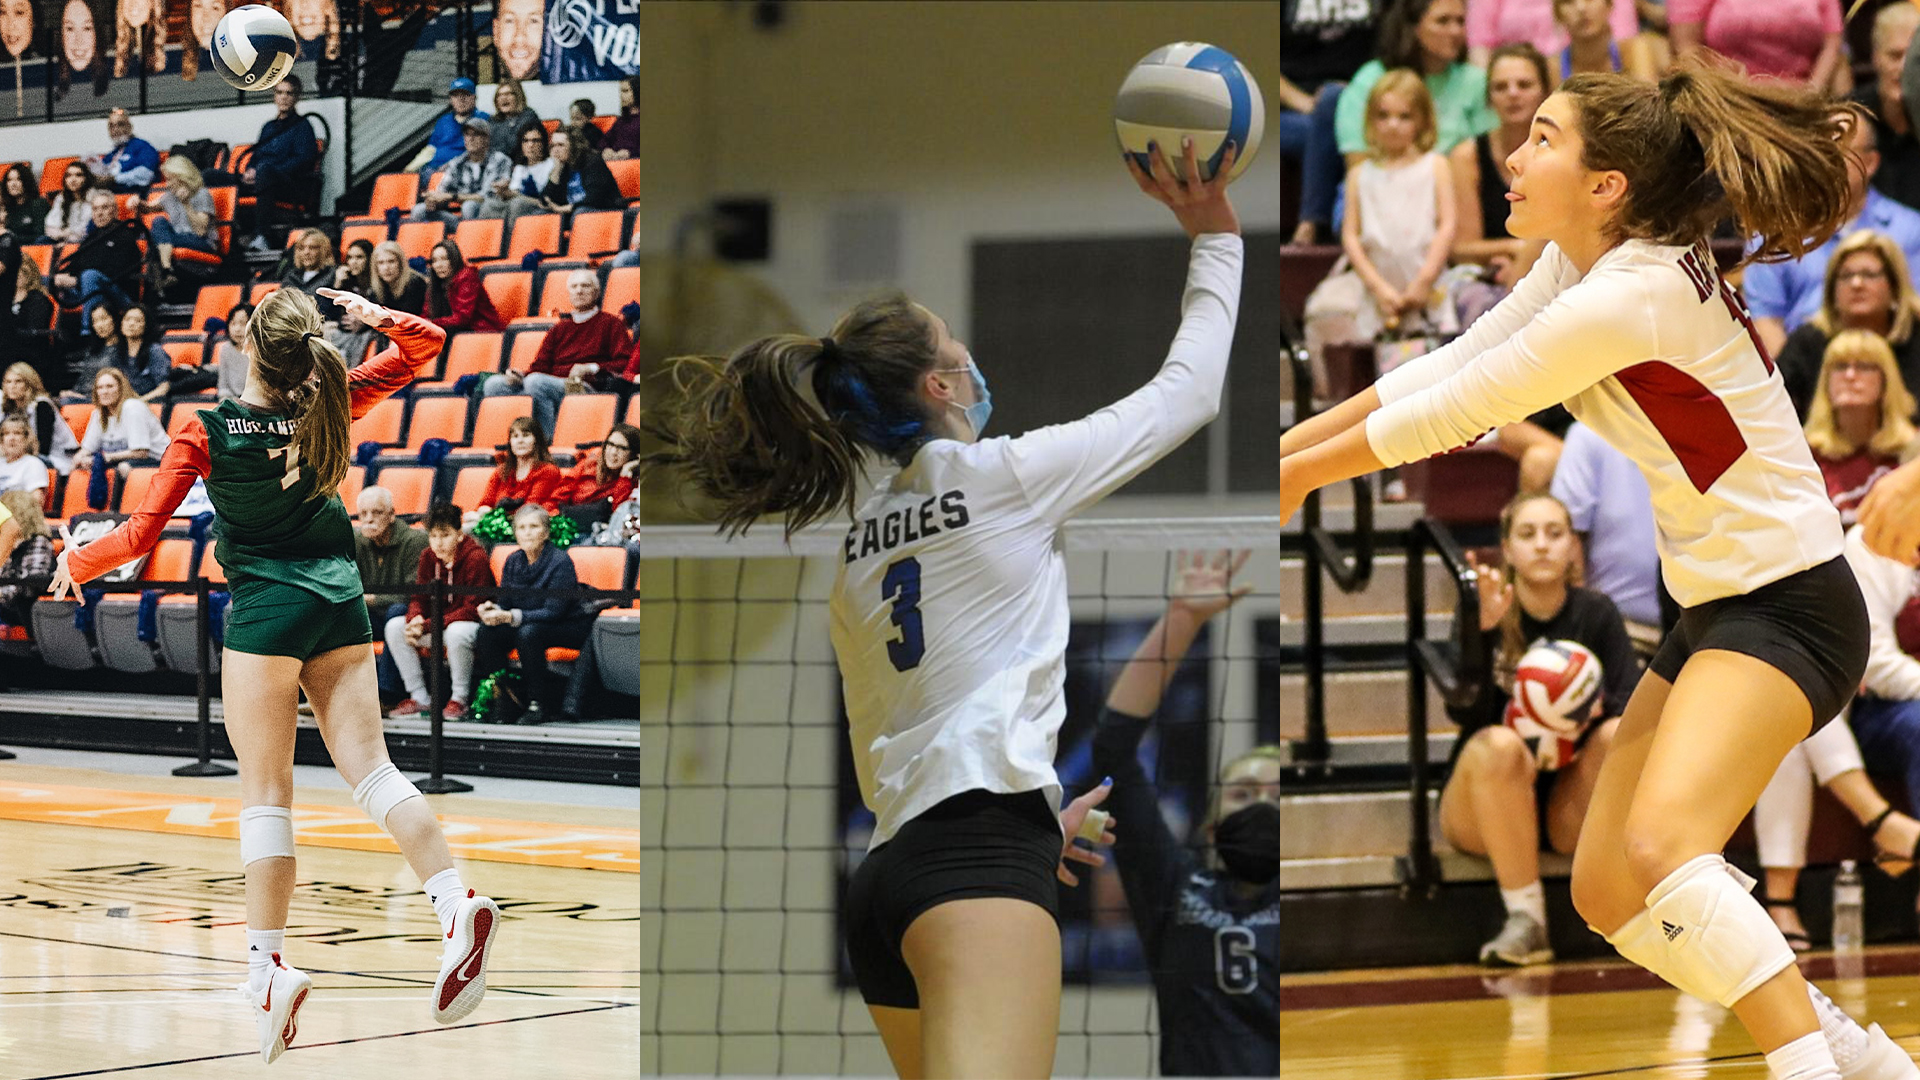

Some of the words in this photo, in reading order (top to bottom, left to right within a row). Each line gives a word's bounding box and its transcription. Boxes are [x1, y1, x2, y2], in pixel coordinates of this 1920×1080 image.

[593, 23, 640, 67] VO
[267, 443, 300, 491] 7
[845, 490, 969, 564] EAGLES
[882, 556, 925, 672] 3
[1214, 925, 1258, 994] 6
